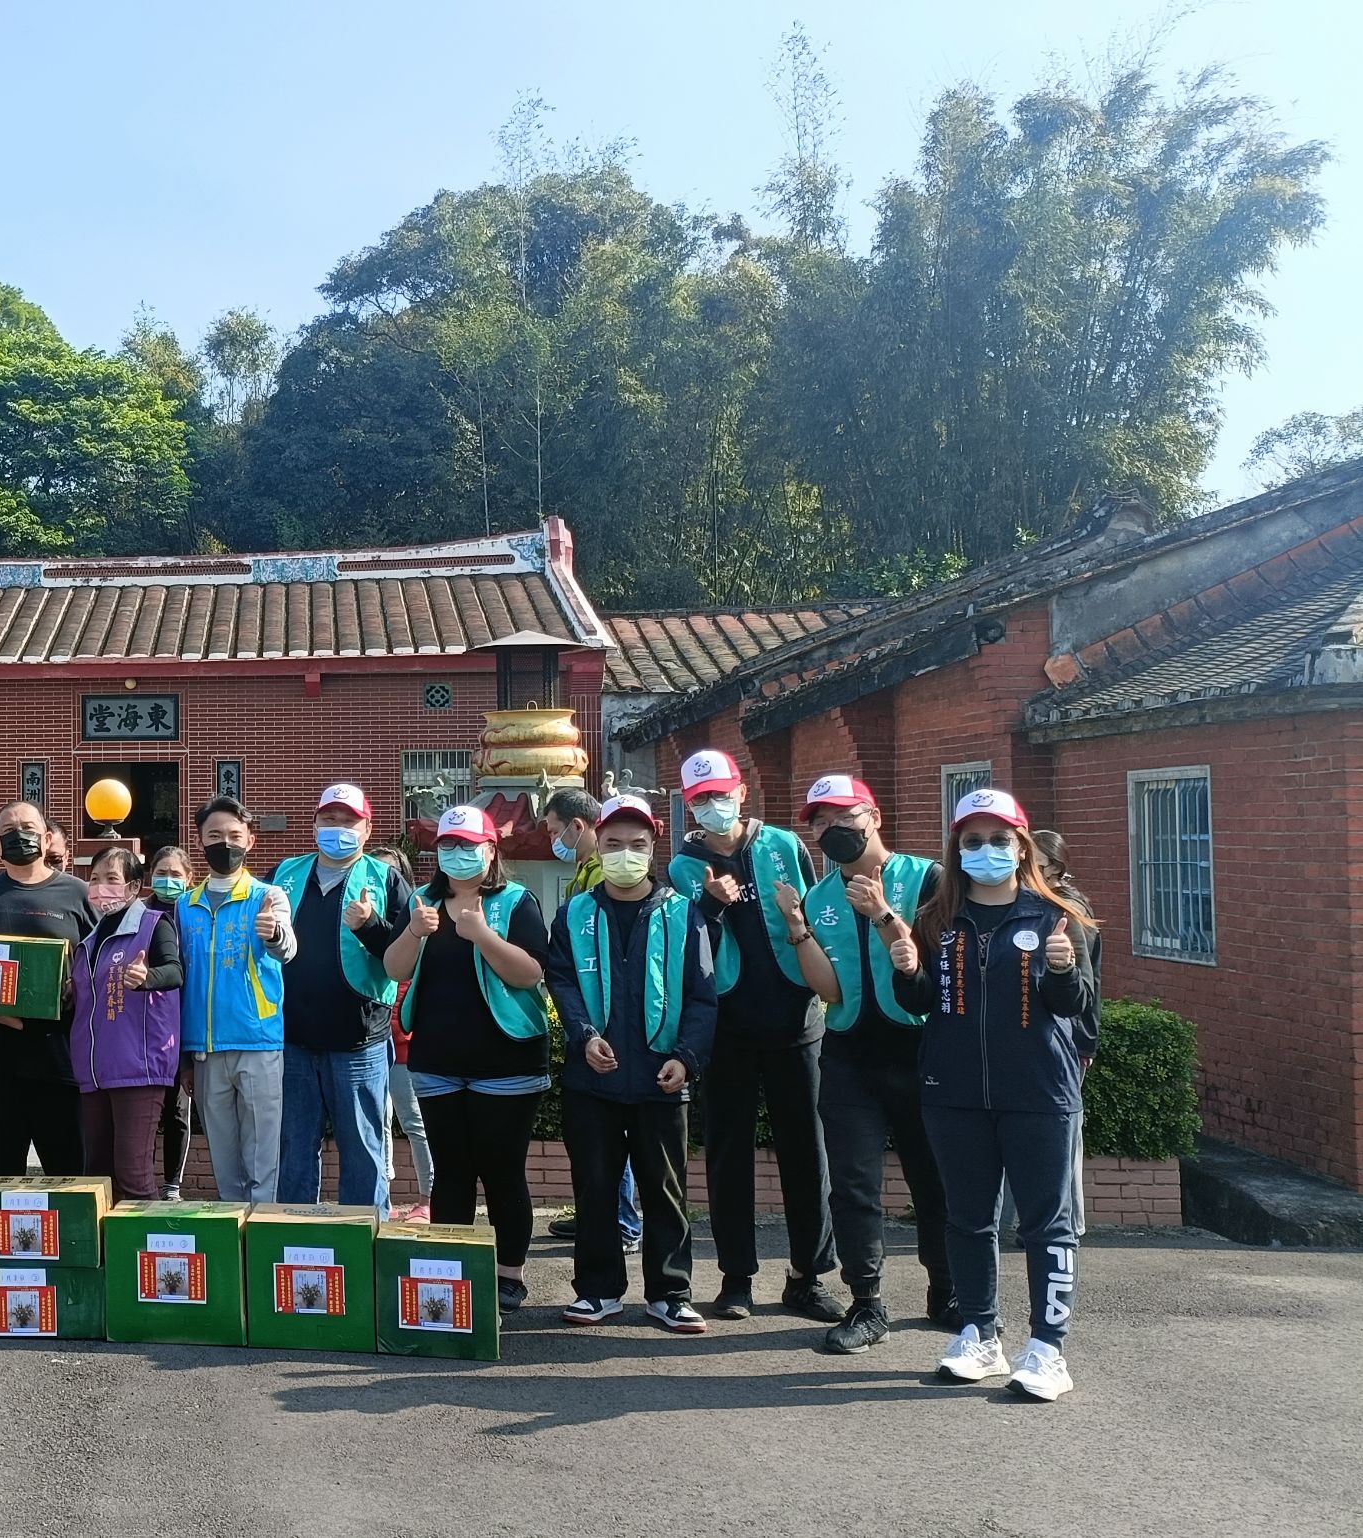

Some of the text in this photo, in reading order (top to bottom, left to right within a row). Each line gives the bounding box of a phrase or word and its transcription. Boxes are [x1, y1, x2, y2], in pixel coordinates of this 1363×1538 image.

[89, 702, 172, 733] 東海堂
[1044, 1245, 1075, 1326] FILA
